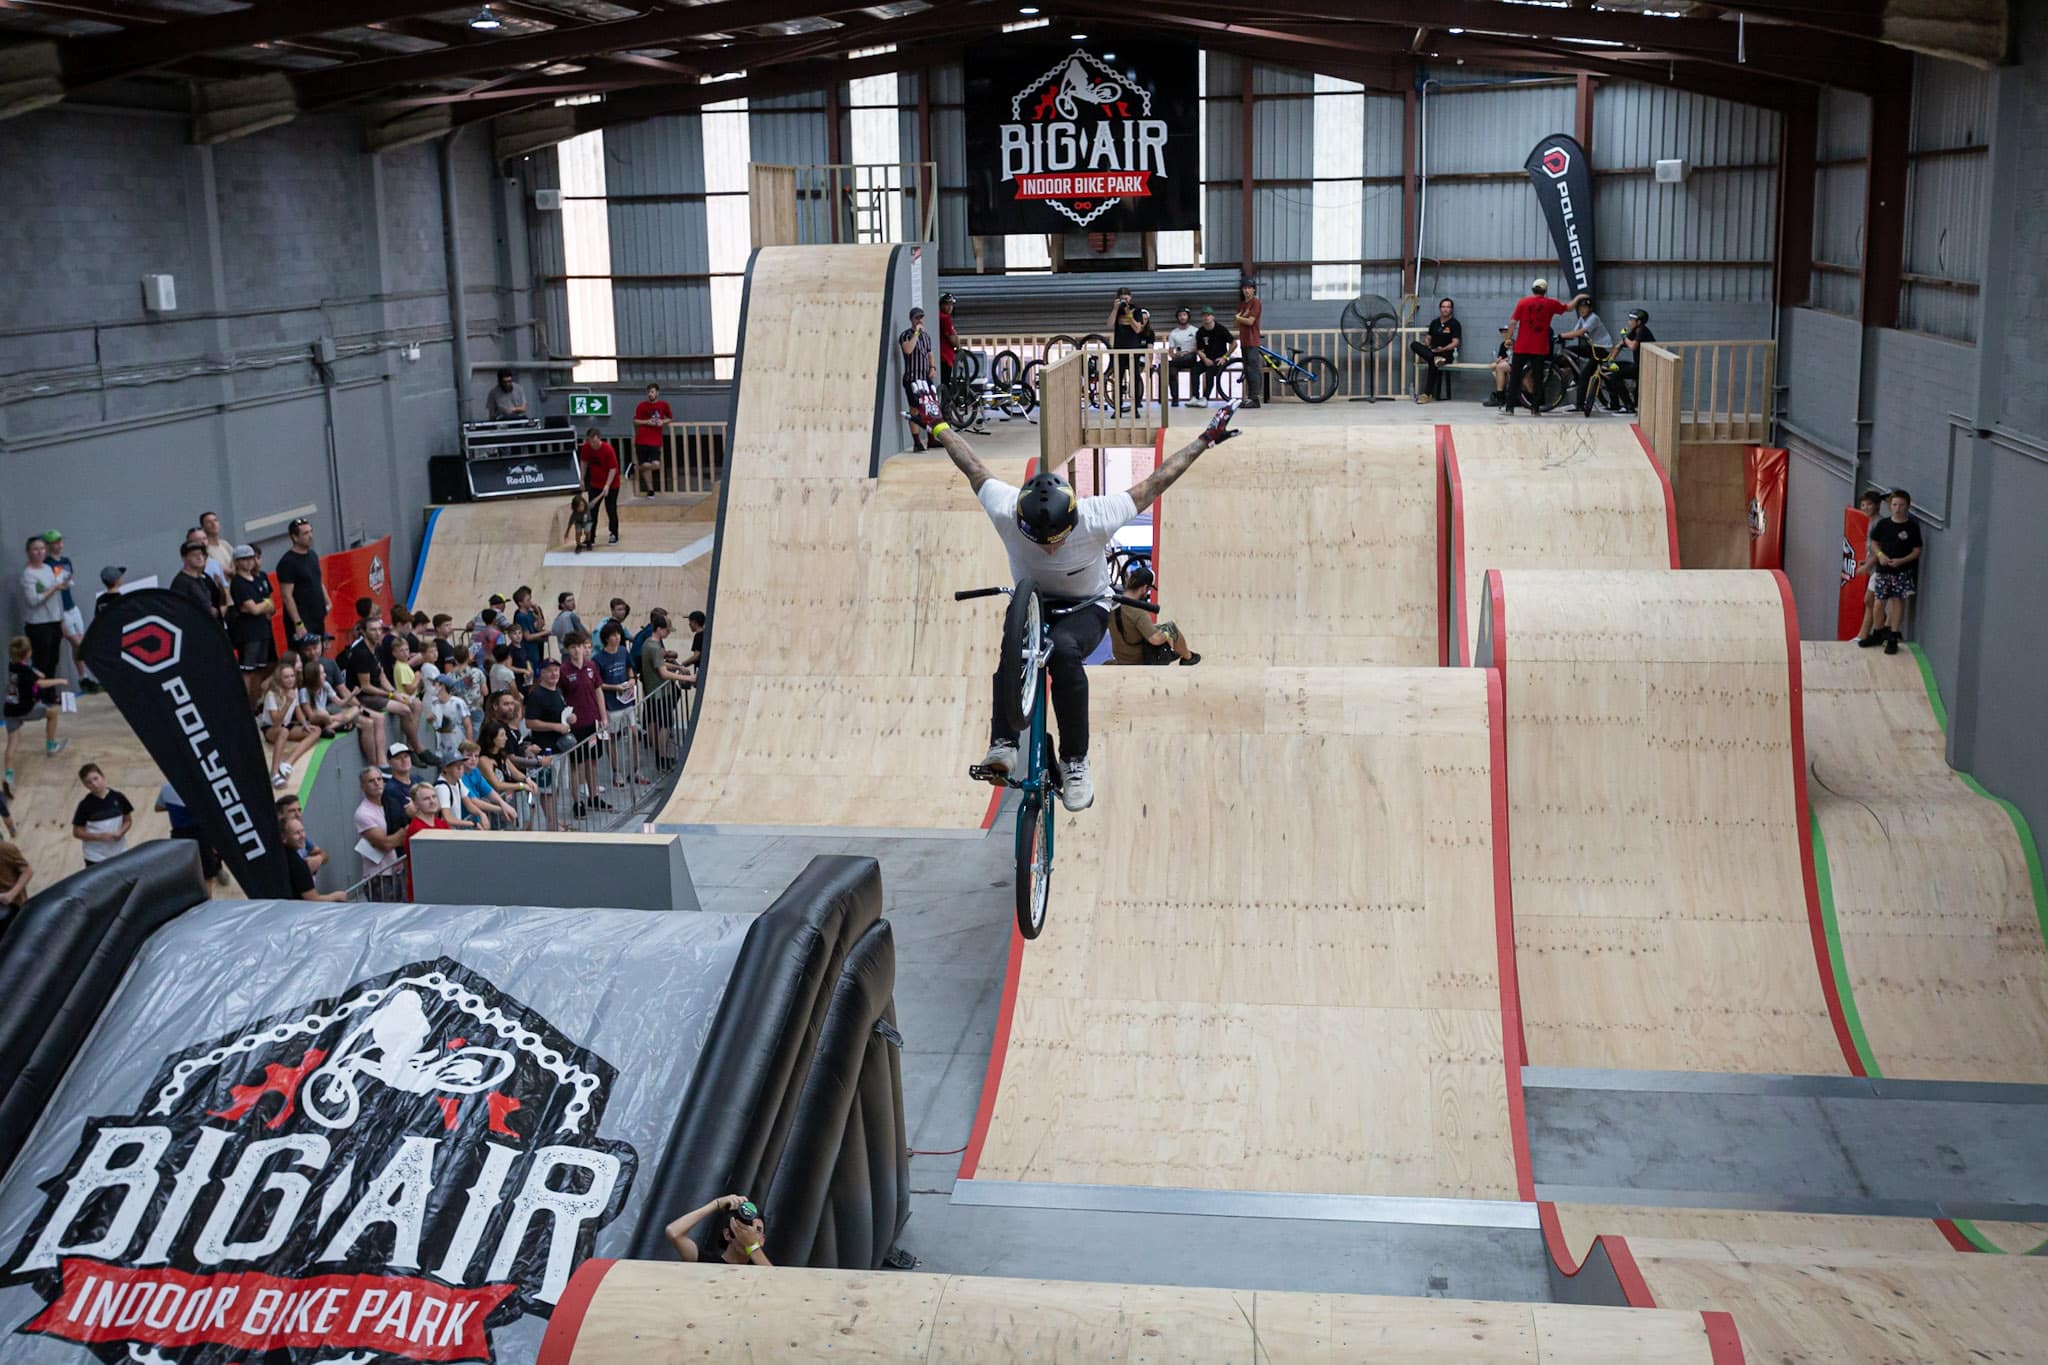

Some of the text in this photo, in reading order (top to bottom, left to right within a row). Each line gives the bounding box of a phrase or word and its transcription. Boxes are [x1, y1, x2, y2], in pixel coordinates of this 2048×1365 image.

[1000, 120, 1168, 182] BIG AIR
[1022, 175, 1143, 195] INDOOR BIKE PARK
[1556, 181, 1588, 290] POLYGON
[506, 472, 544, 485] Red Bull
[161, 676, 266, 861] POLYGON
[10, 1126, 622, 1304] BIG AIR
[66, 1275, 481, 1347] INDOOR BIKE PARK
